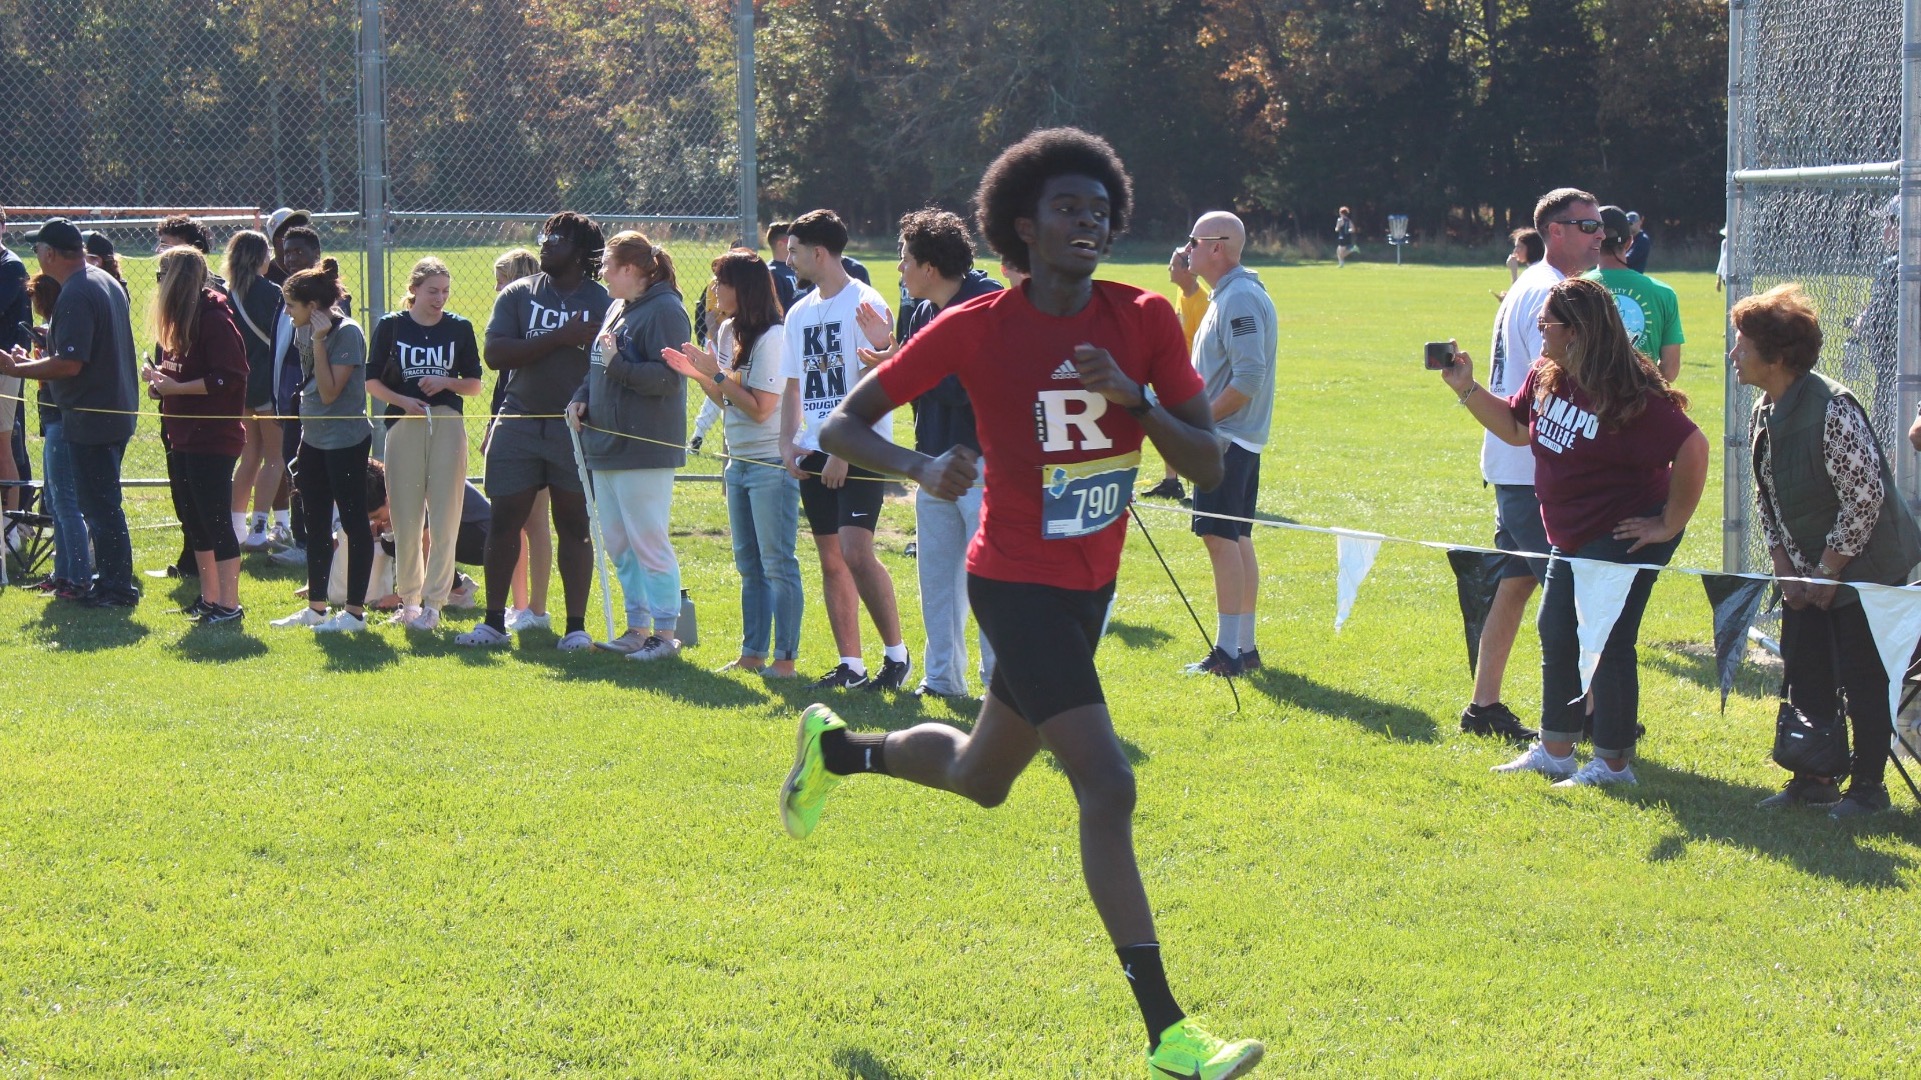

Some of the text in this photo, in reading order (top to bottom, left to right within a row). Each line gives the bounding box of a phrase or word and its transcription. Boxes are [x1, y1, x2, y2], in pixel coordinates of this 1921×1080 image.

[397, 341, 455, 370] TCNJ
[1034, 402, 1045, 442] NEWARK
[1038, 389, 1112, 452] R
[1536, 416, 1576, 449] COLLEGE
[1072, 483, 1120, 519] 790
